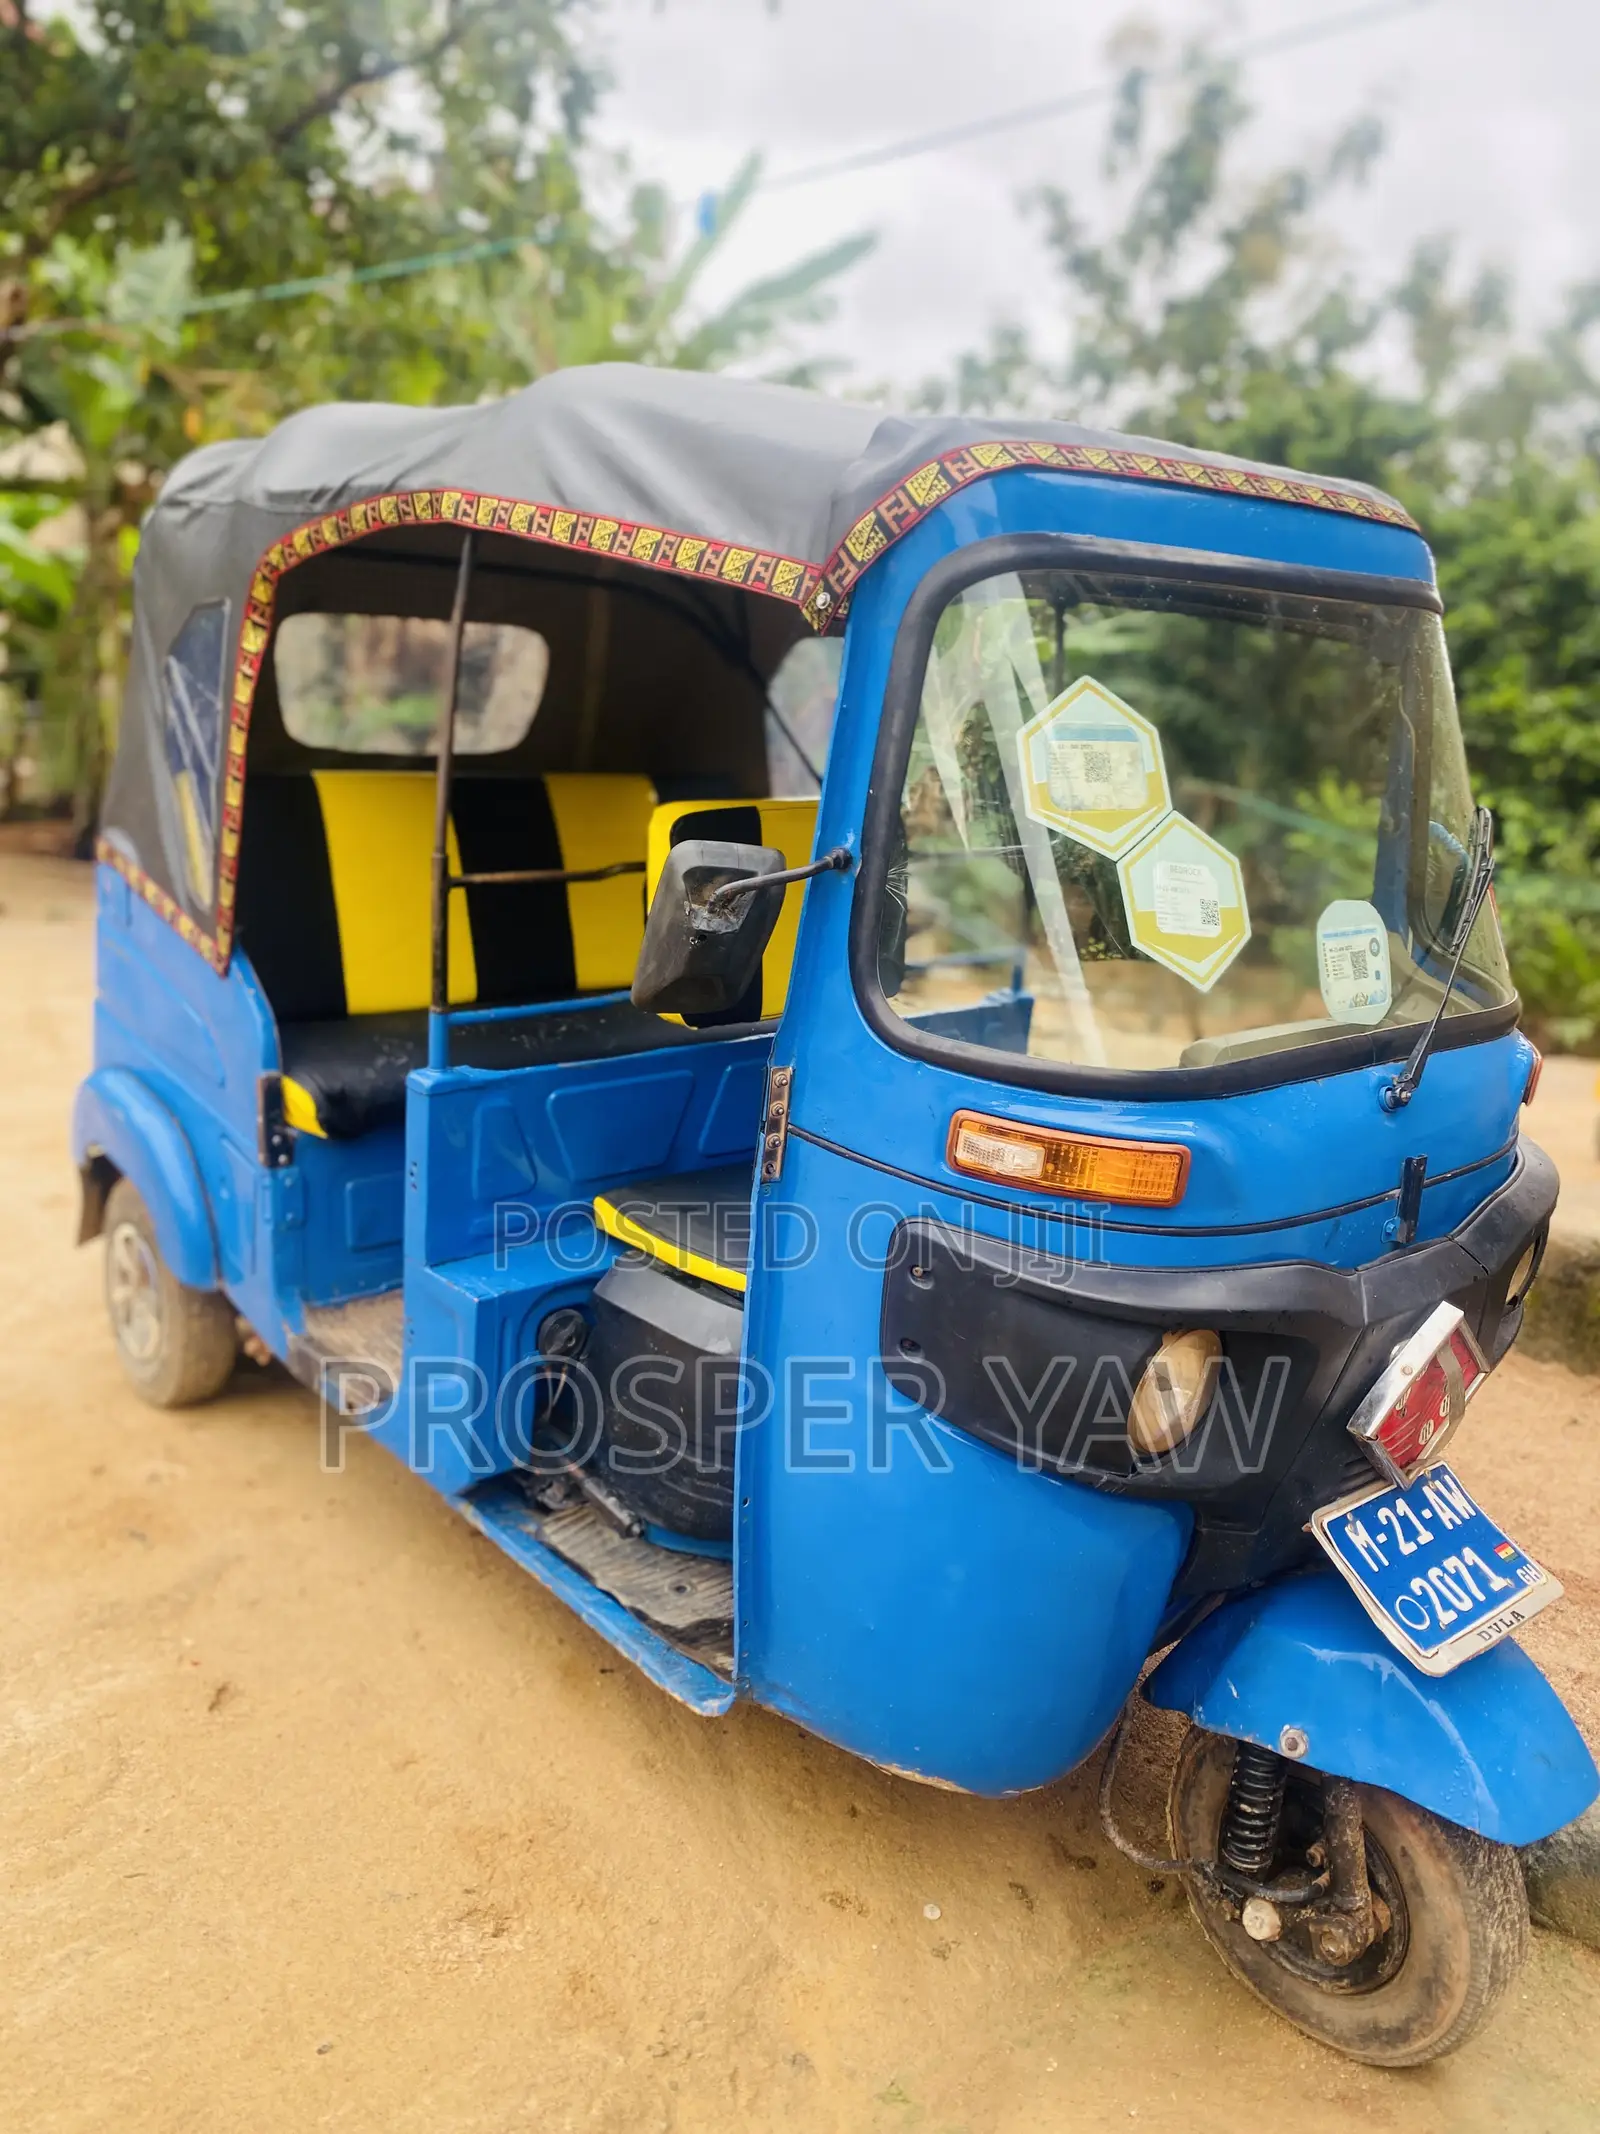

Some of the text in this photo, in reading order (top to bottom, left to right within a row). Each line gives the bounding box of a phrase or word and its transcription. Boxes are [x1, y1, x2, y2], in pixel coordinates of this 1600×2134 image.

[1344, 1474, 1477, 1573] M-21-AW
[1411, 1547, 1508, 1626] 2071
[1515, 1563, 1542, 1586] GH
[1476, 1609, 1526, 1642] DVLA
